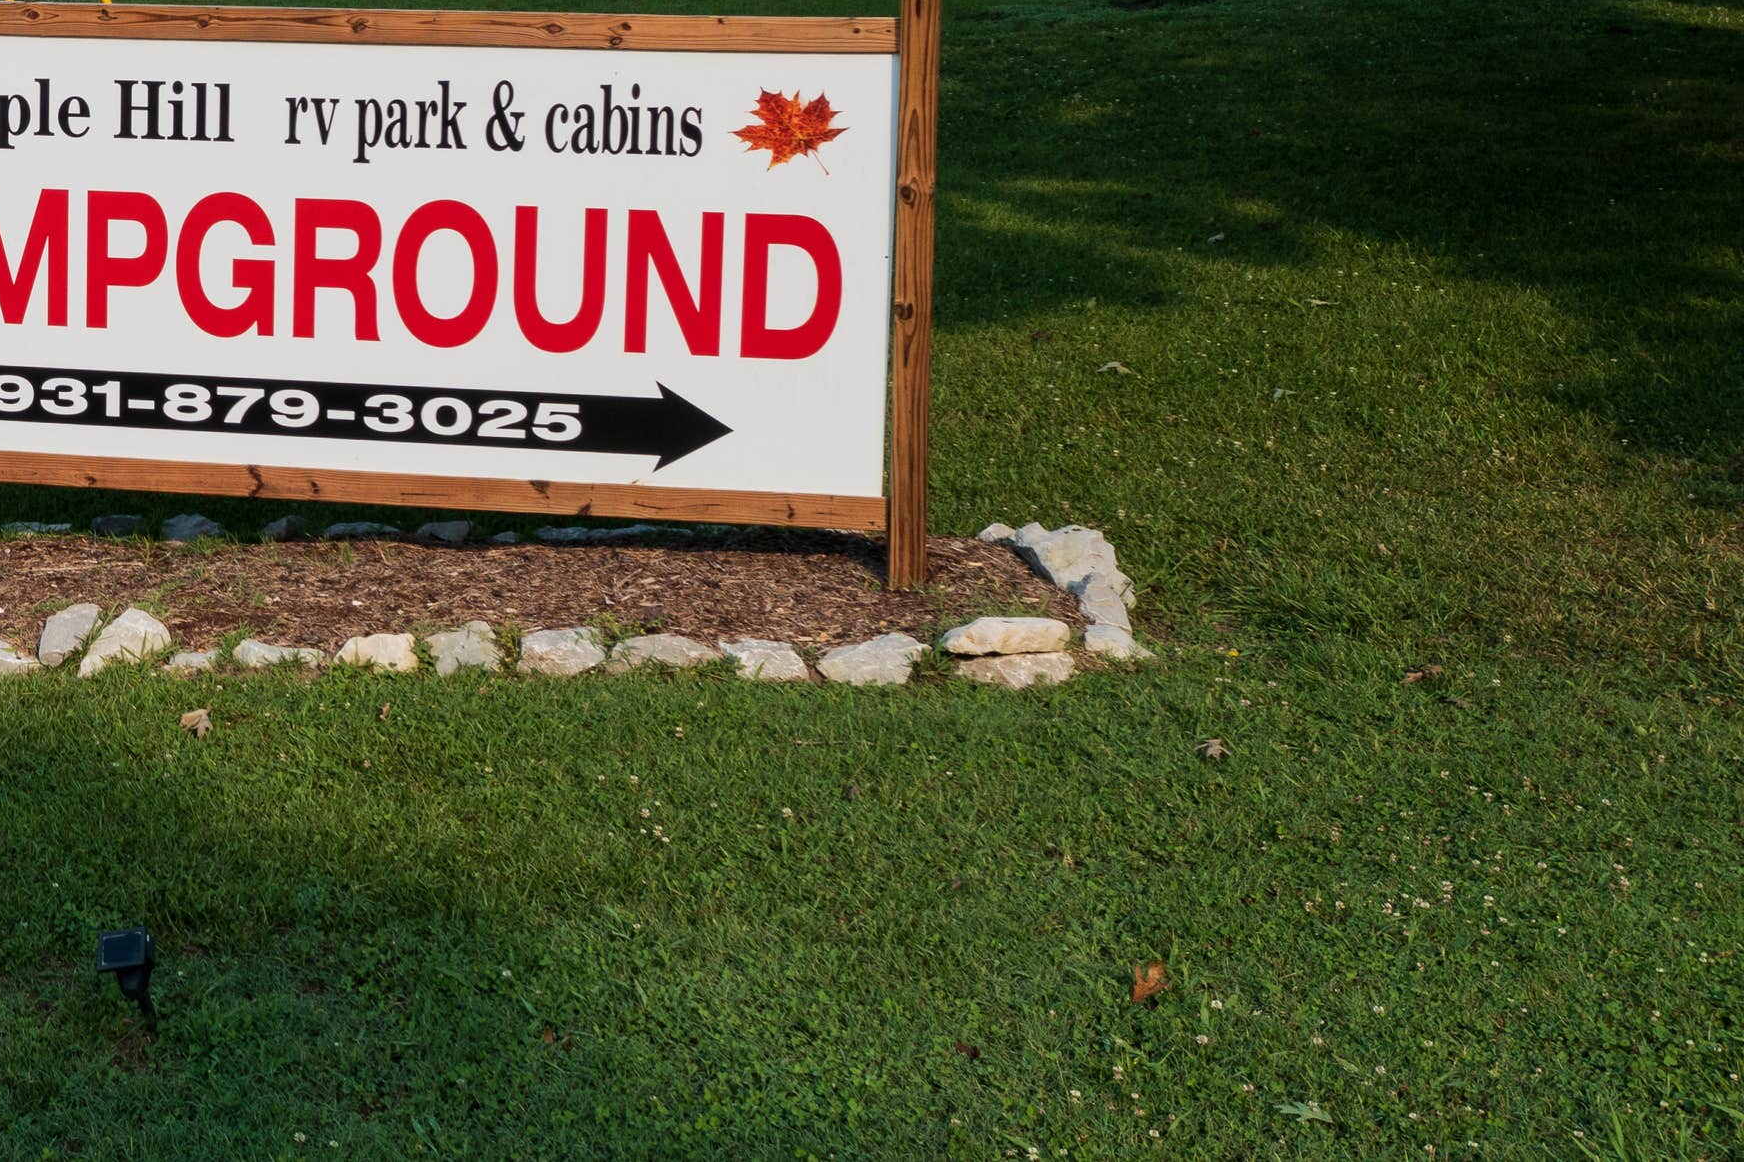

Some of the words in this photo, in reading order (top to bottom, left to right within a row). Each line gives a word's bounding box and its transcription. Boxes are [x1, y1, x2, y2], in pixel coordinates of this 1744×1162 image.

[113, 79, 235, 143] Hill
[284, 96, 340, 146] rv
[352, 80, 468, 164] park
[485, 79, 526, 152] &
[544, 83, 703, 158] cabins
